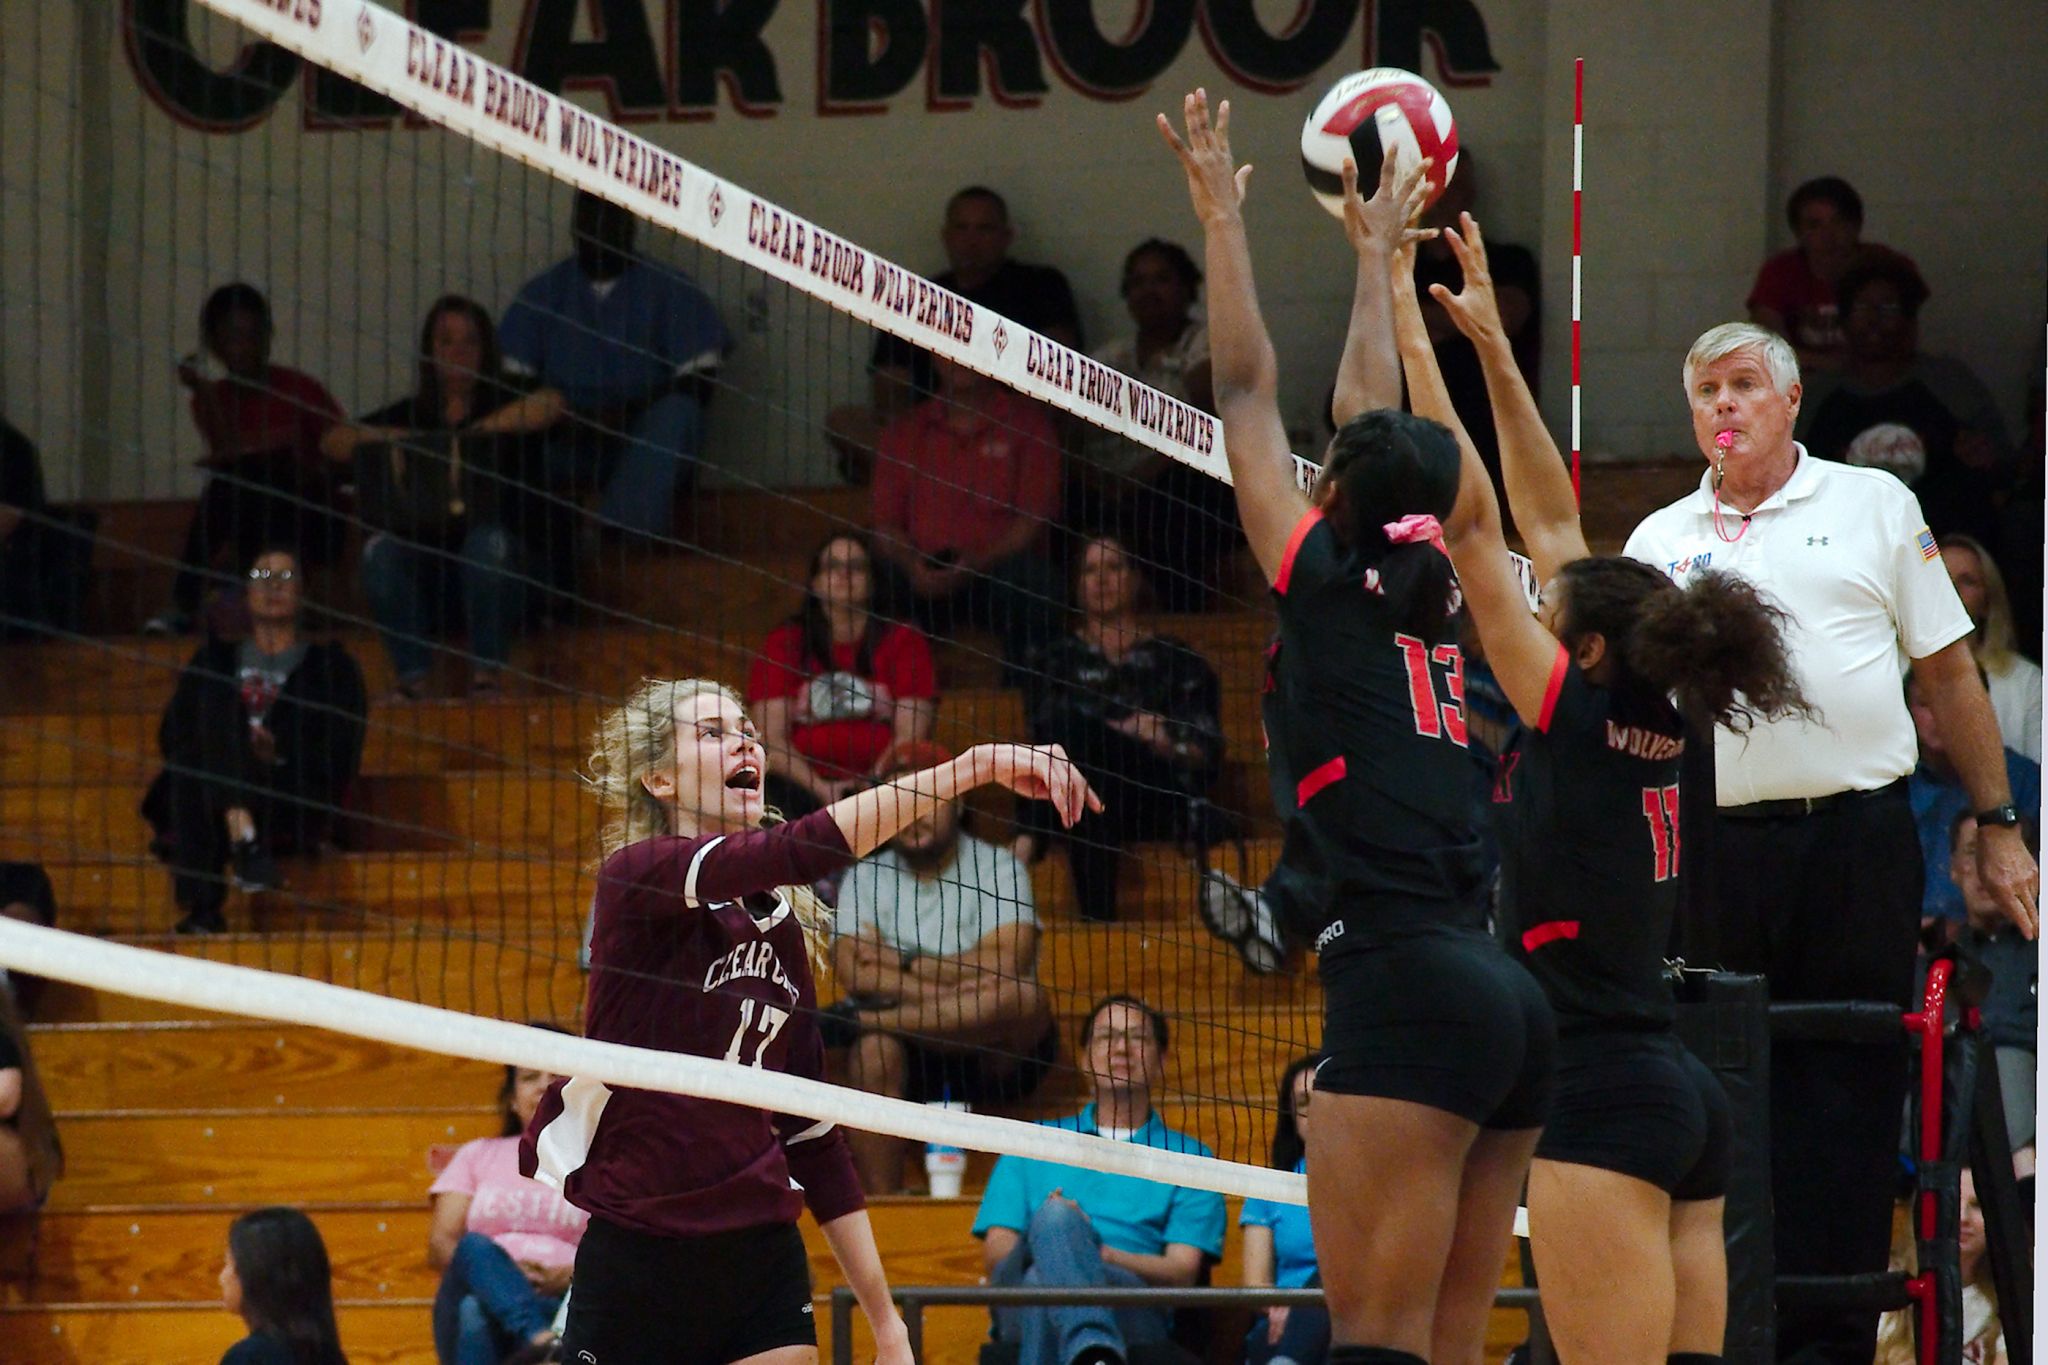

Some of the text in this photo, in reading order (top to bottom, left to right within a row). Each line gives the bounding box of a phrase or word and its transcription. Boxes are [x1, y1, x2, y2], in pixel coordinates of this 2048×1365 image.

[118, 0, 786, 134] CAR
[406, 29, 683, 210] CLEAR BROOK WOLVERINES
[748, 200, 974, 345] CLEAR BROOK WOLVERINES
[1026, 334, 1214, 456] CLEAR BROOK WOLVERINES
[1394, 631, 1469, 749] 13
[1642, 782, 1681, 882] 11
[702, 939, 773, 994] CLEAR
[723, 997, 792, 1070] 17
